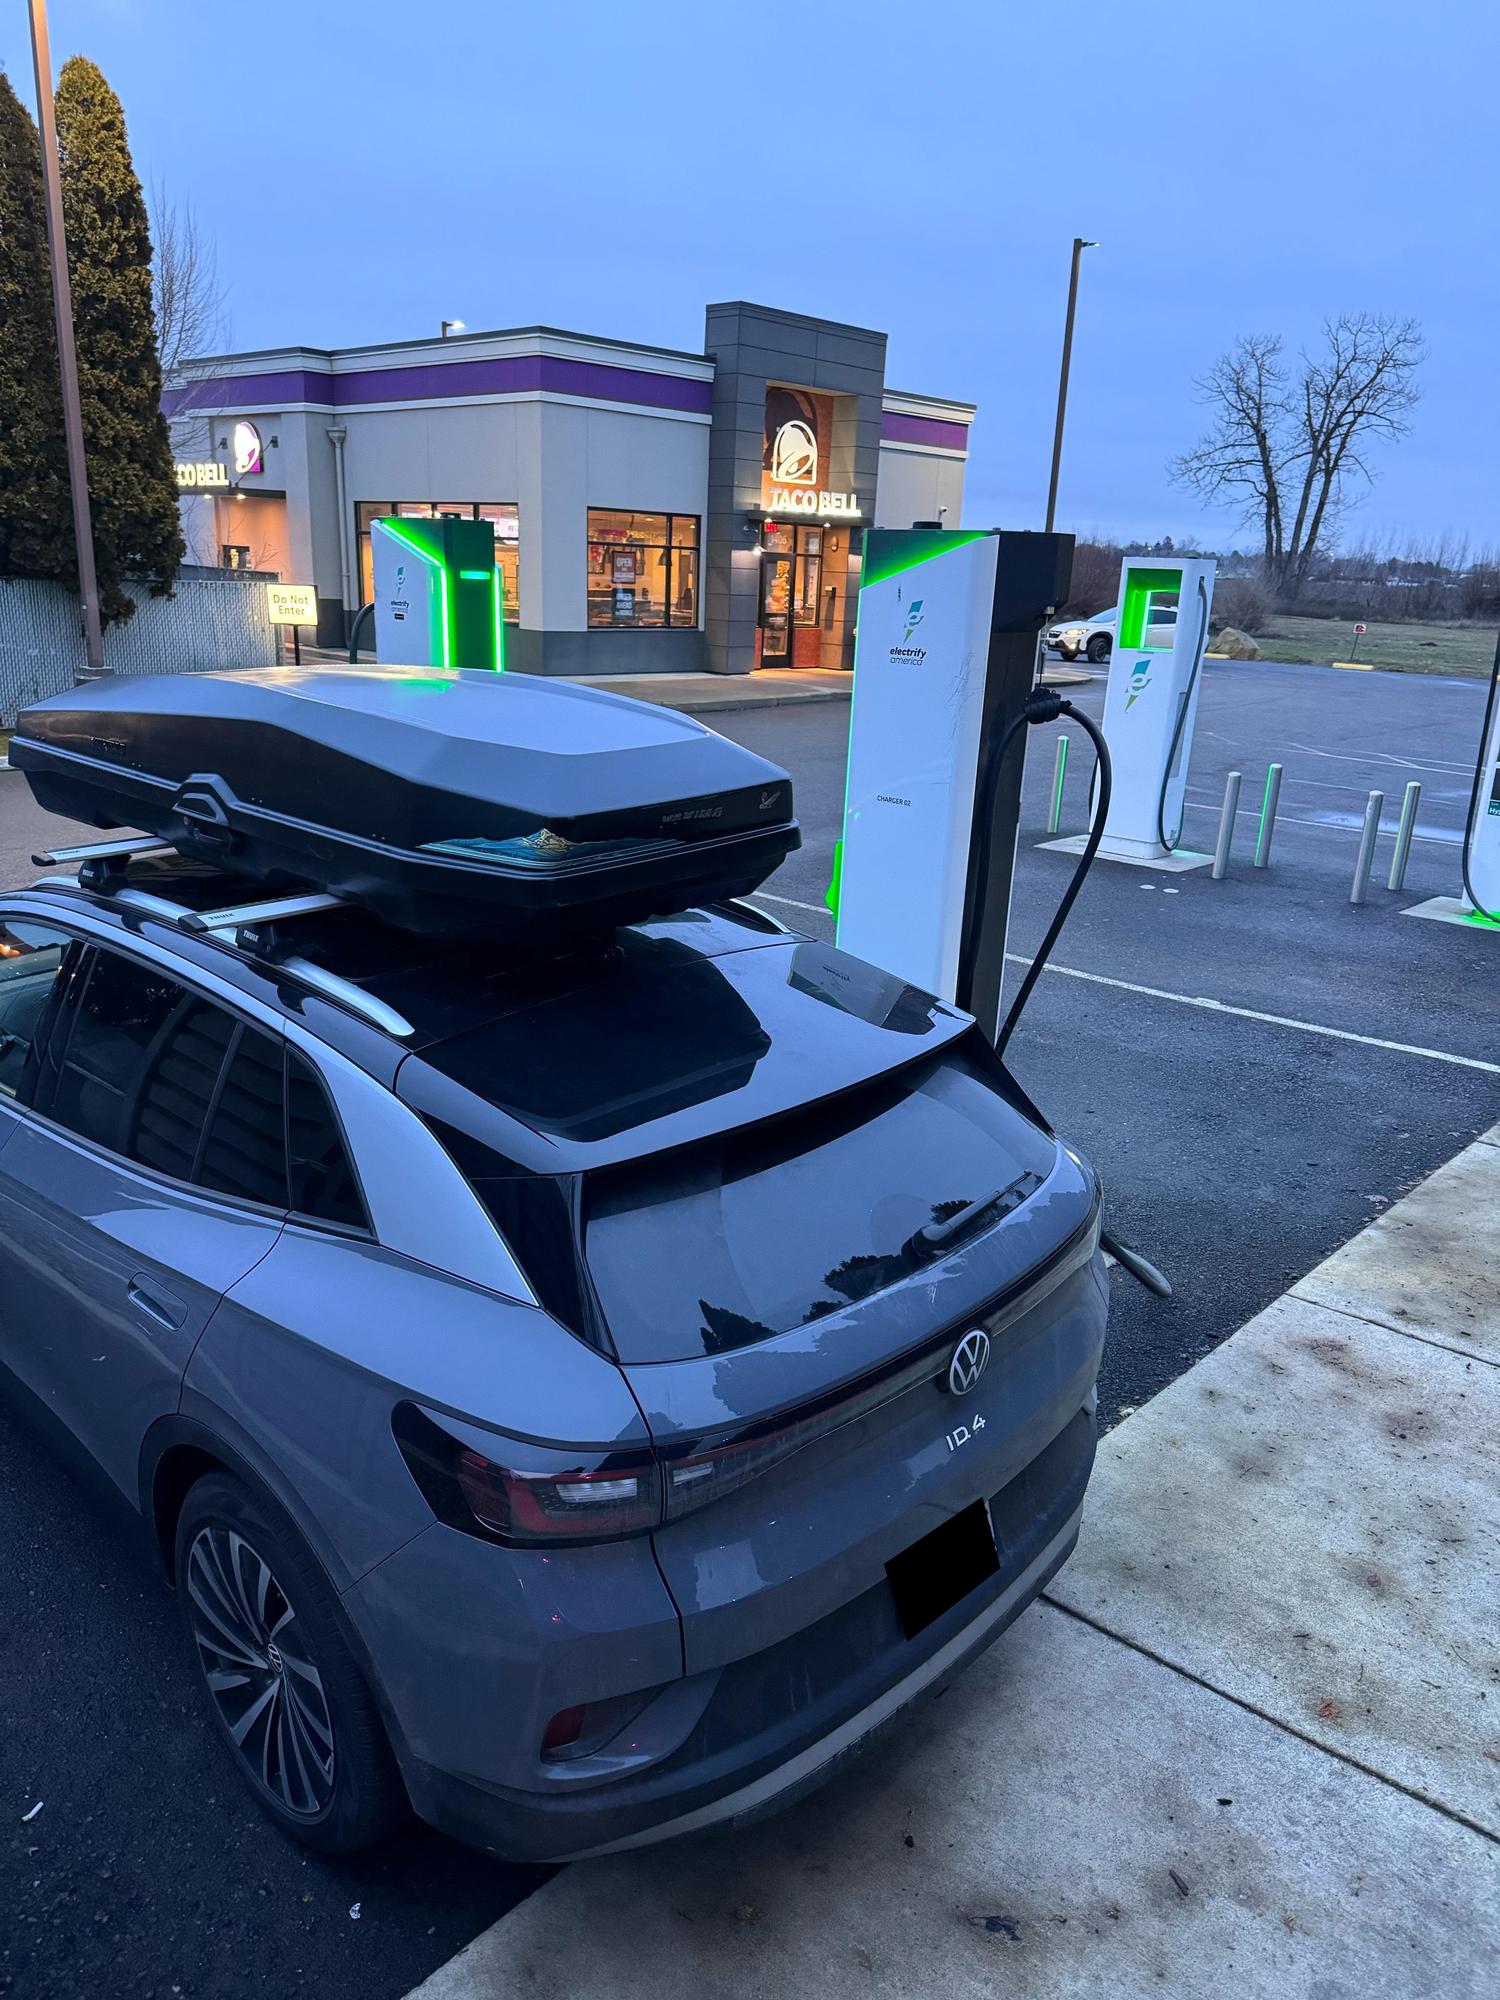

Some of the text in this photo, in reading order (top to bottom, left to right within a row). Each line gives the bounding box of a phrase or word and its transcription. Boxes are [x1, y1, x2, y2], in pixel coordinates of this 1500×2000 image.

[196, 463, 229, 486] BELL
[768, 487, 862, 516] TACO BELL
[273, 594, 309, 605] Do Not
[279, 605, 305, 616] Enter
[889, 646, 927, 659] electrify
[889, 657, 923, 666] america
[877, 795, 903, 805] CHARGER
[208, 912, 236, 921] THULE
[243, 929, 260, 943] THULE
